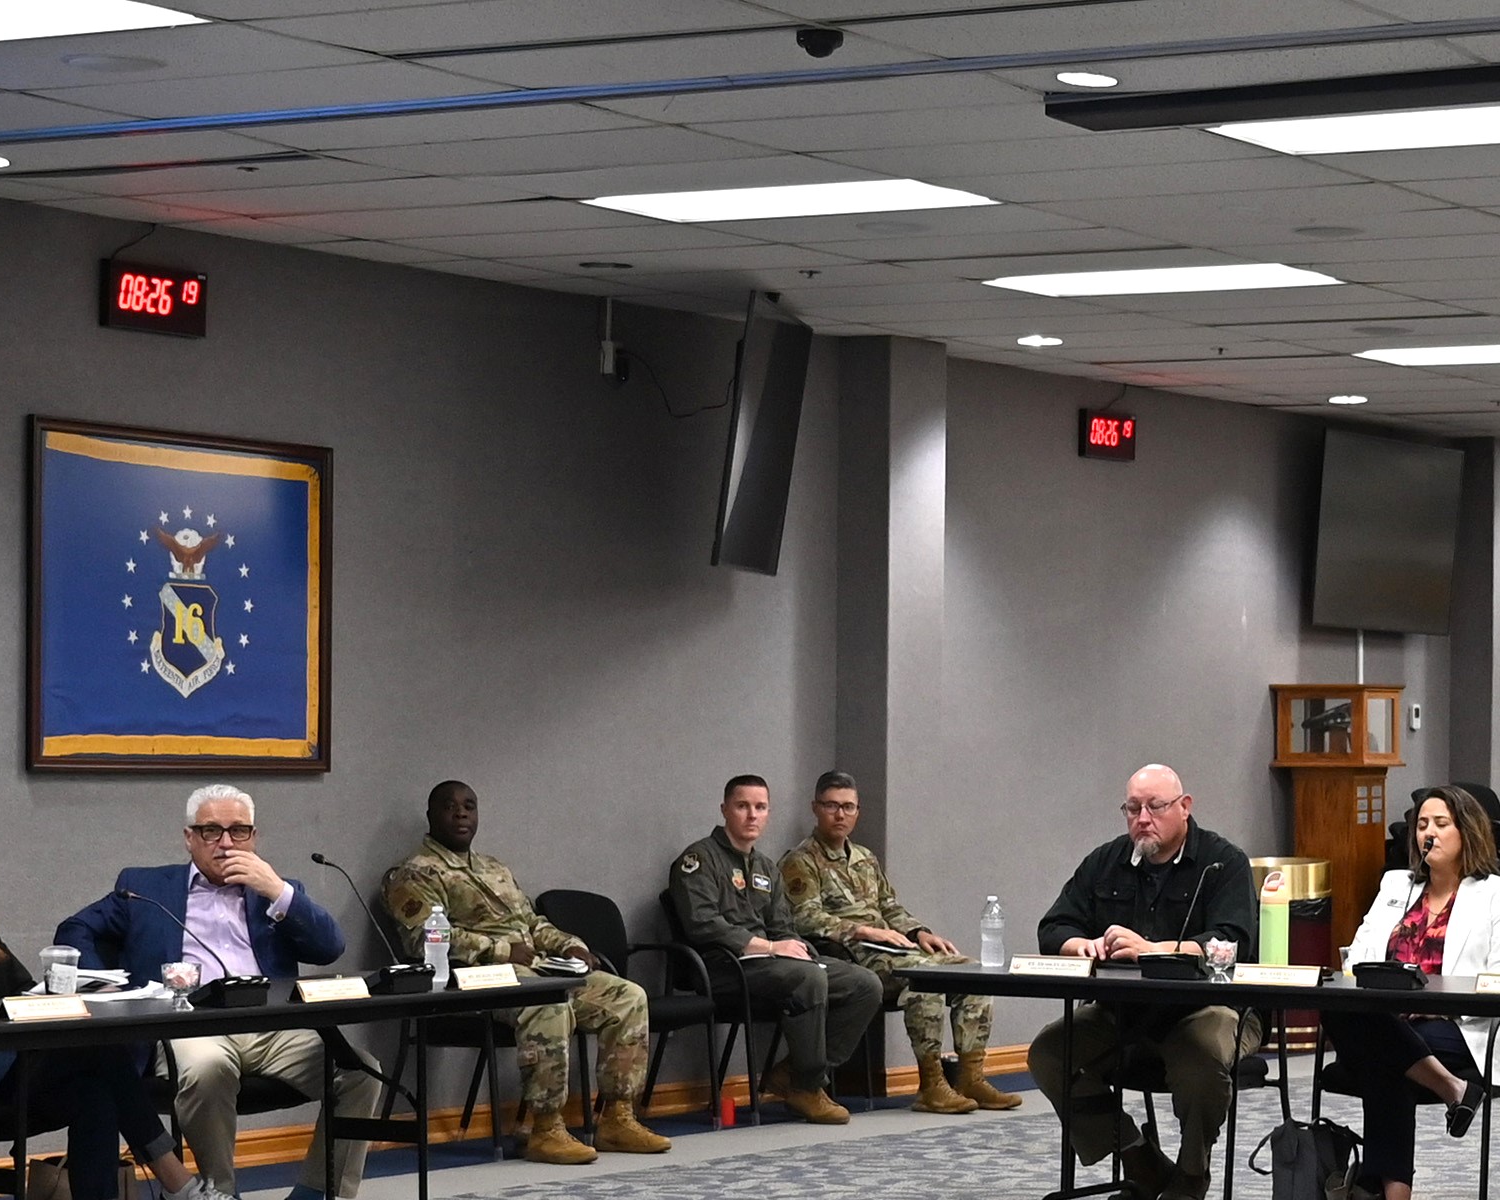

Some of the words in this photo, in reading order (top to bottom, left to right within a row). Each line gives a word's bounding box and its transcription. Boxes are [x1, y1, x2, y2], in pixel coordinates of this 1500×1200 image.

[118, 273, 174, 315] 08:26
[182, 281, 199, 304] 19
[1122, 420, 1133, 438] 19
[172, 602, 206, 645] 16
[187, 676, 201, 691] AIR
